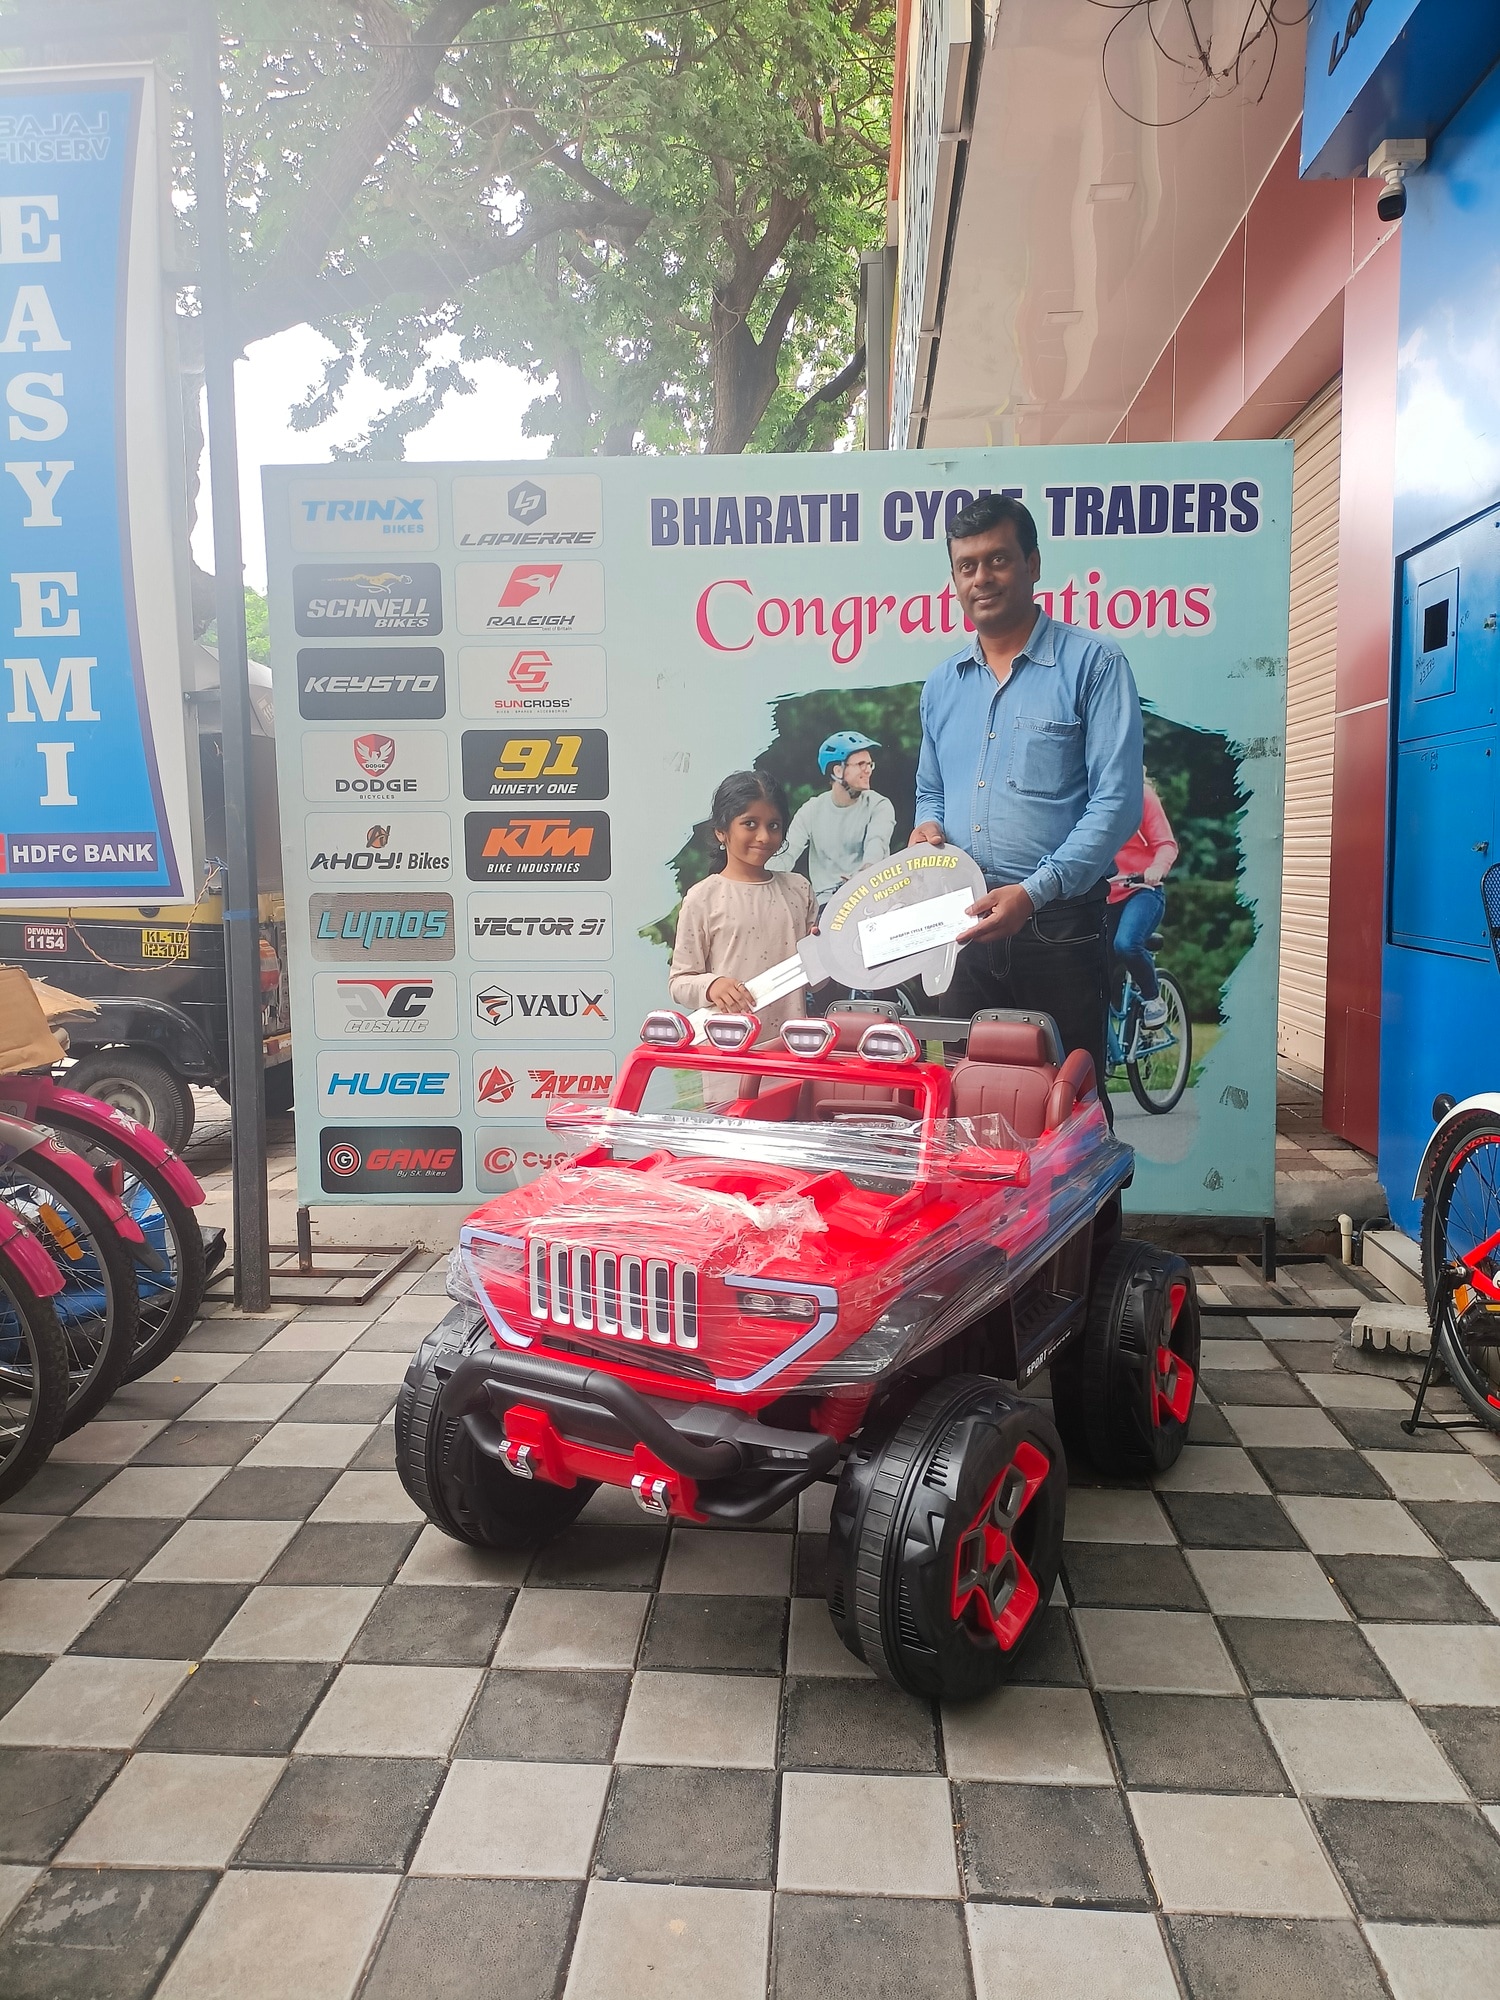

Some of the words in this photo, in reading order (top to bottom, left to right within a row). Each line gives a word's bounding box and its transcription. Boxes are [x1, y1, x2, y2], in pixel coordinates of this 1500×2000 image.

[302, 495, 424, 522] TRINX
[651, 493, 860, 546] BHARATH
[1046, 482, 1260, 536] TRADERS
[383, 524, 424, 534] BIKES
[460, 531, 597, 546] LAPIERRE
[306, 598, 430, 618] SCHNELL
[374, 618, 429, 628] BIKES
[486, 615, 575, 626] RALEIGH
[4, 571, 101, 806] EMI
[304, 675, 439, 693] KEYSTO
[494, 699, 571, 708] SUNCROSS
[493, 735, 582, 779] 91
[335, 779, 417, 792] DODGE
[489, 783, 544, 795] NINETY
[547, 783, 578, 794] ONE
[482, 818, 595, 857] KTM
[12, 843, 79, 865] HDFC
[84, 843, 153, 863] BANK
[310, 852, 402, 871] AHOY!
[408, 849, 450, 870] Bikes
[486, 863, 512, 873] BIKE
[516, 862, 580, 873] INDUSTRIES
[830, 886, 869, 931] BHARATH
[869, 863, 903, 888] CYCLE
[906, 855, 959, 871] TRADERS
[873, 876, 911, 901] Mysore
[27, 927, 63, 936] DEVARAJA
[473, 917, 574, 936] VECTOR
[27, 936, 64, 950] 1154
[516, 988, 606, 1019] VAUX
[344, 1019, 430, 1033] COSMIC
[327, 1072, 450, 1095] HUGE
[527, 1070, 613, 1098] AVON
[365, 1149, 457, 1171] GANG
[396, 1170, 408, 1178] By
[1025, 1348, 1047, 1378] SPORT
